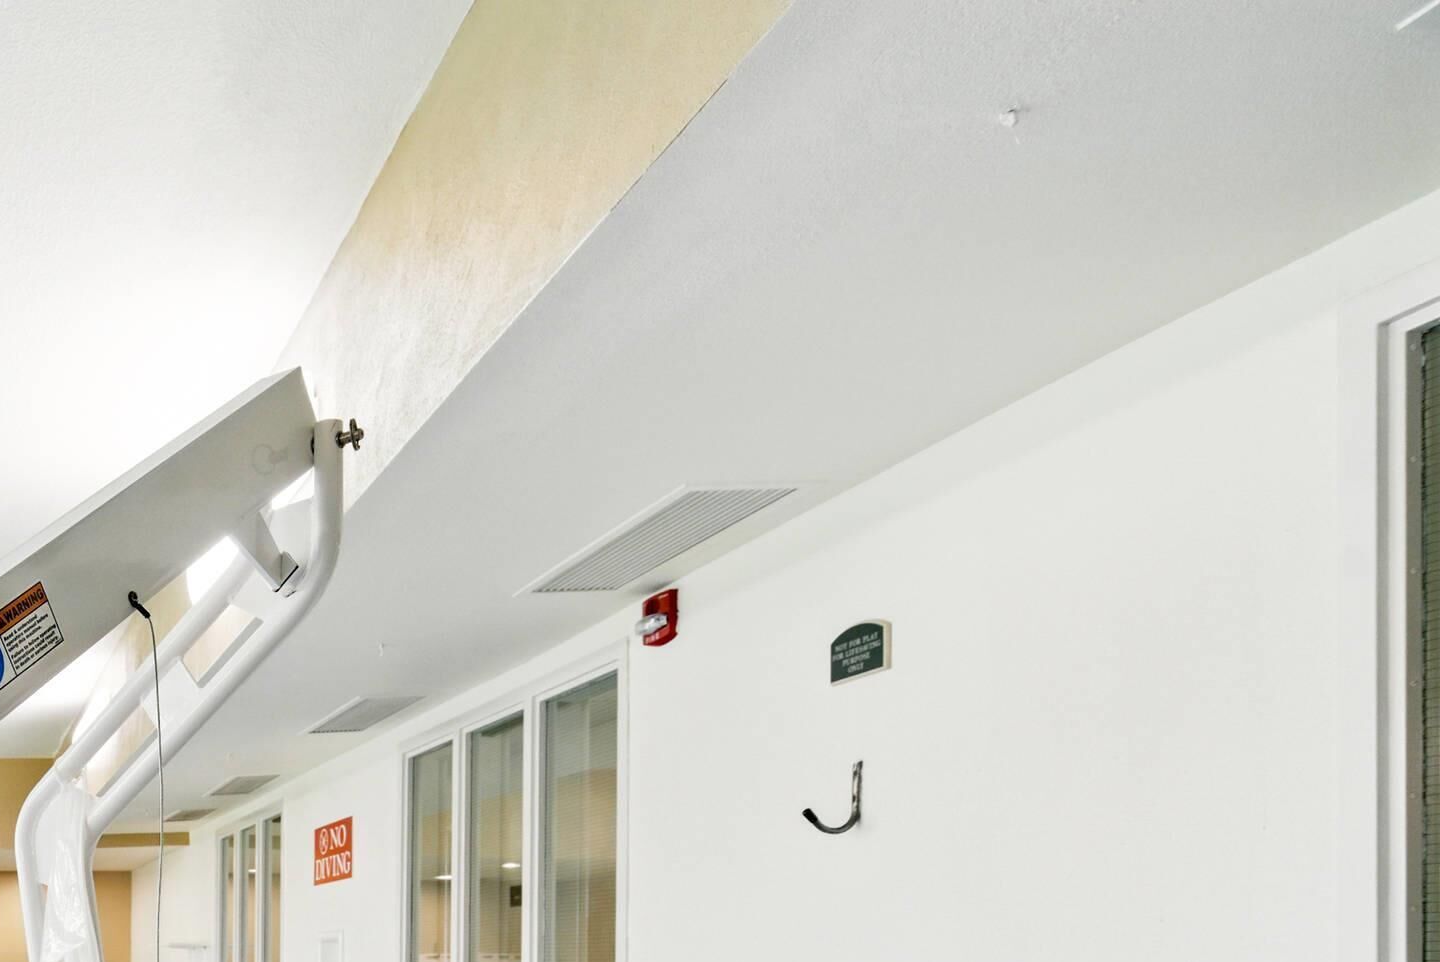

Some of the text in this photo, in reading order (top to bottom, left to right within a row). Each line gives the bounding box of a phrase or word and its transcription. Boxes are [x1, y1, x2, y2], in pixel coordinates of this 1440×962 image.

[3, 588, 44, 622] WARNING
[849, 638, 861, 648] FOR
[329, 825, 346, 850] NO
[315, 850, 351, 881] DIVING
